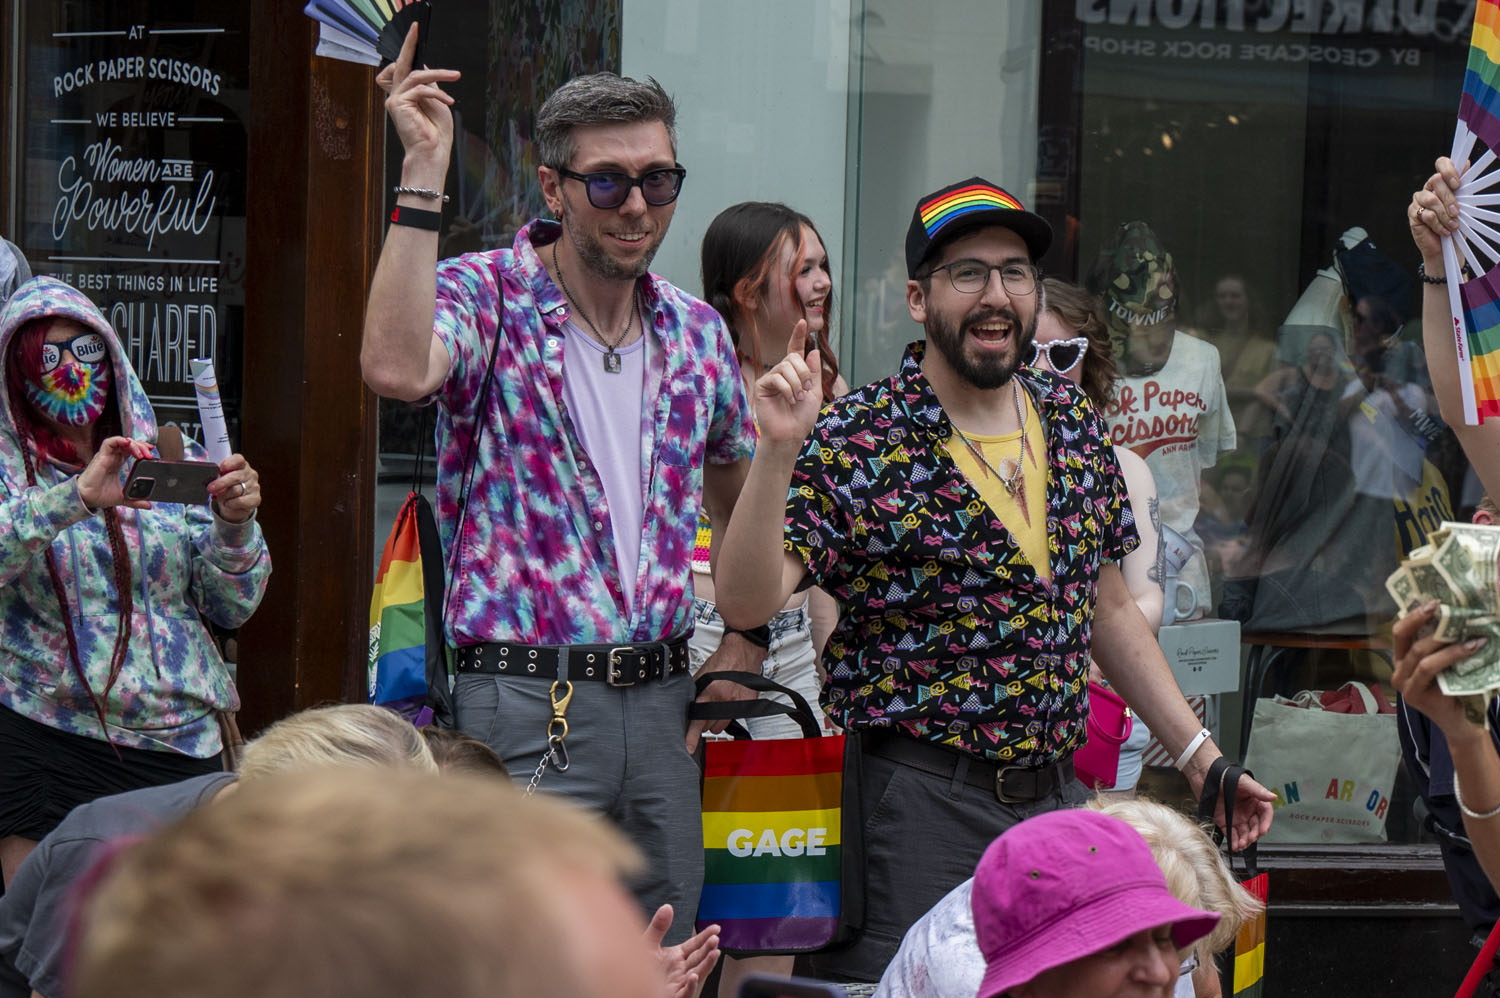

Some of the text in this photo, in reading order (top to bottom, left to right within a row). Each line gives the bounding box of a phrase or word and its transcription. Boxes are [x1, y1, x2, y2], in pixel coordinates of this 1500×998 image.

[128, 25, 145, 40] AT
[54, 56, 221, 97] ROCK PAPER SCISSORS
[96, 112, 175, 127] WE BELIEVE
[83, 137, 193, 183] Women ARE
[52, 156, 217, 252] Powerful
[78, 274, 112, 289] BEST
[116, 275, 165, 291] THINGS
[170, 276, 183, 292] IN
[188, 277, 218, 293] LIFE
[1109, 298, 1168, 326] TOWNIE
[77, 340, 105, 358] Blue
[1144, 381, 1207, 412] Paper
[727, 827, 827, 858] GAGE
